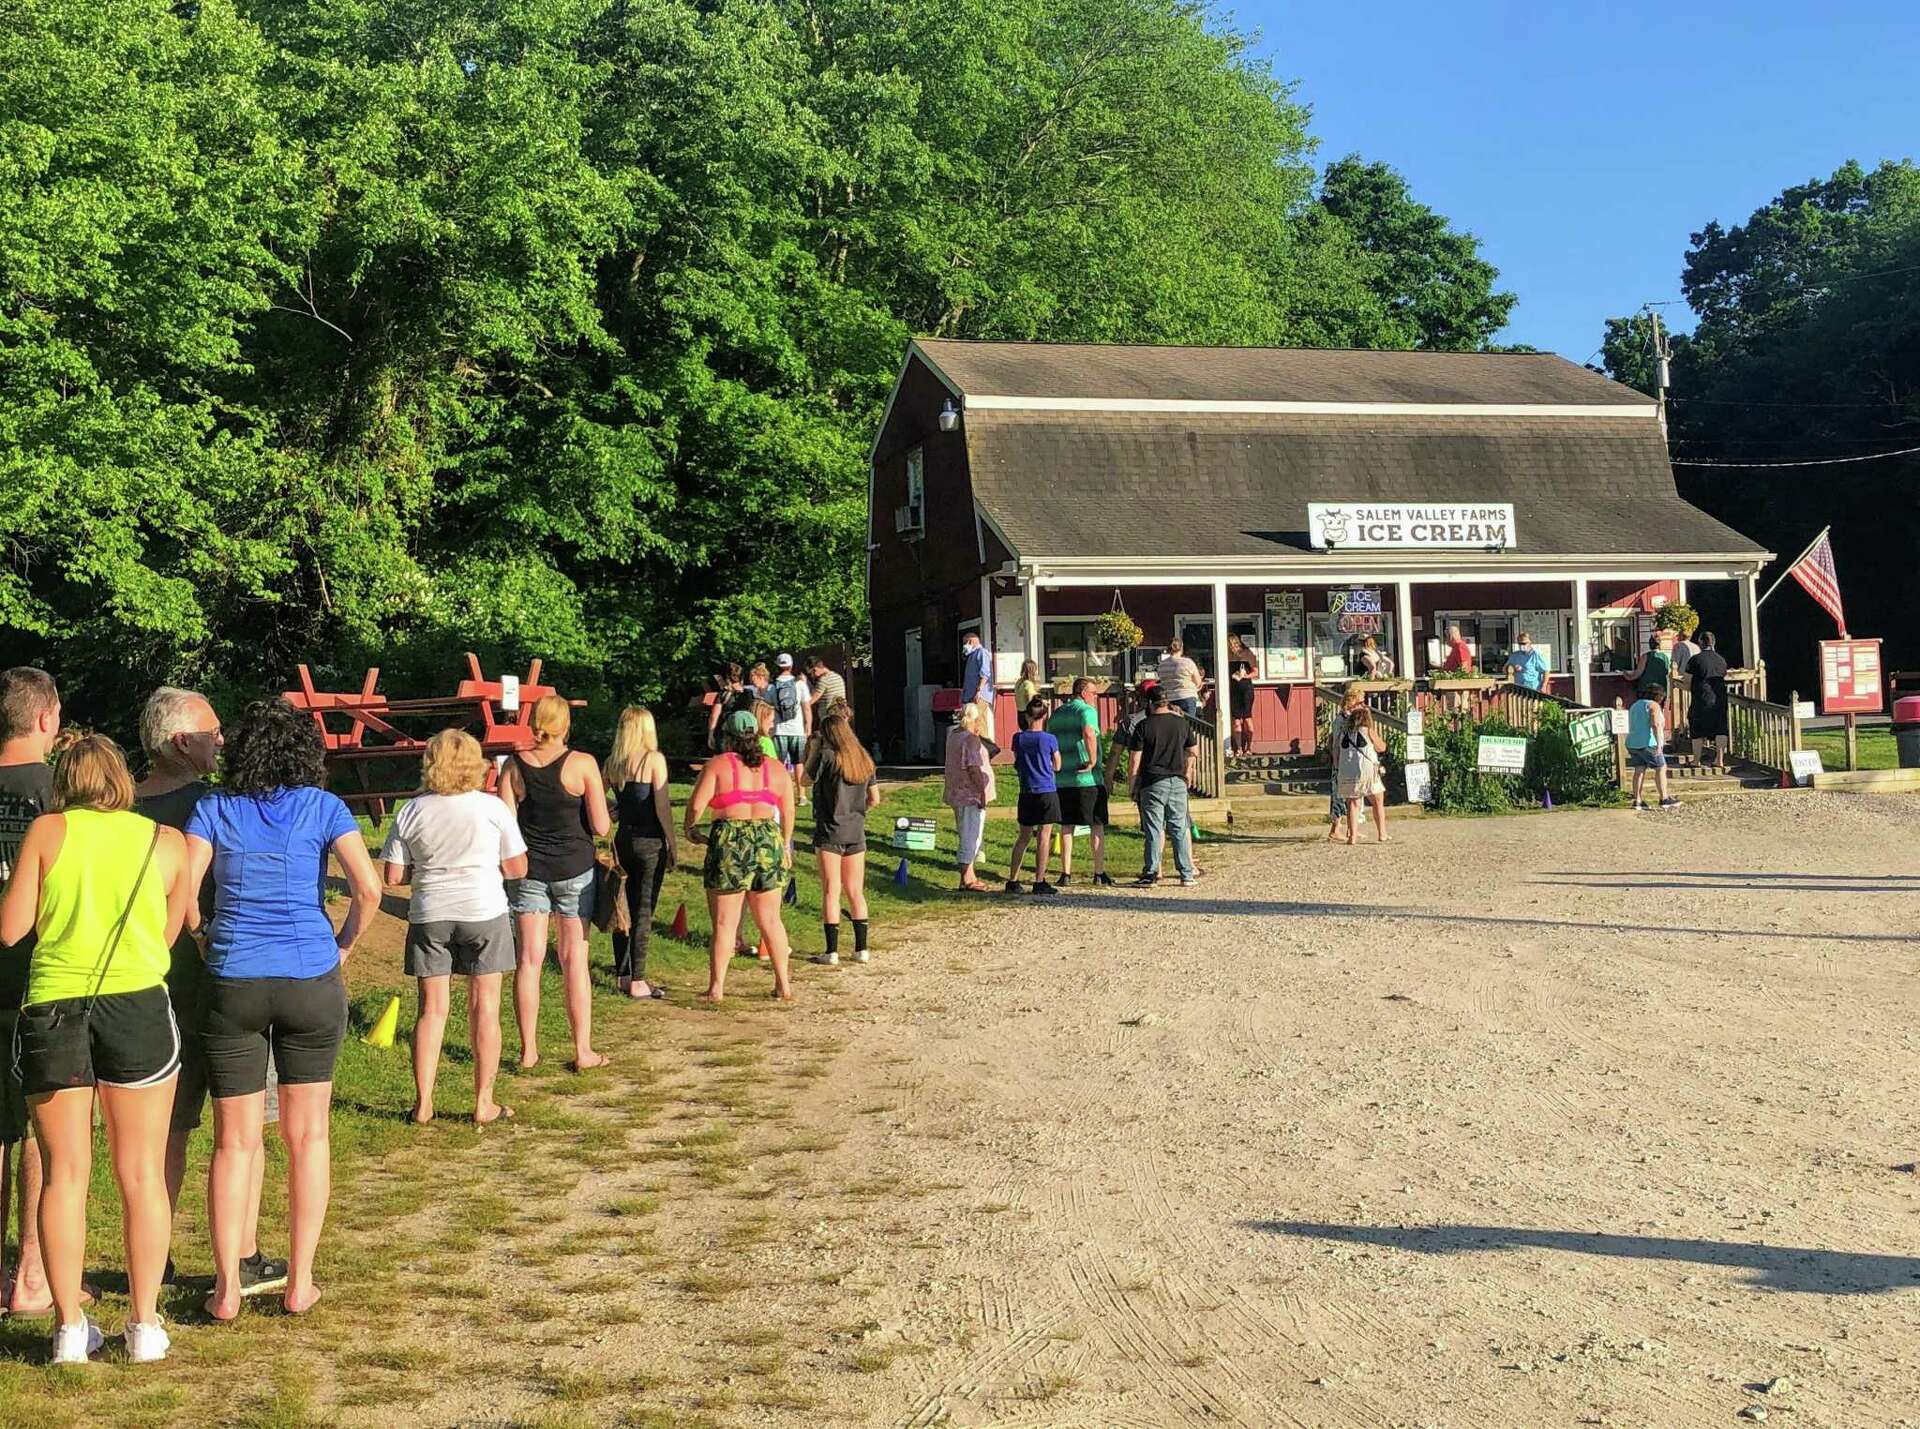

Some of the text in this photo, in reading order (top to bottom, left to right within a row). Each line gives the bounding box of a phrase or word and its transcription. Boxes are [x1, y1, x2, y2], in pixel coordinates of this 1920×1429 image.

[1356, 509, 1507, 521] SALEM VALLEY FARMS
[1358, 524, 1507, 542] ICE CREAM
[1265, 595, 1300, 604] SALEM
[1353, 590, 1372, 602] ICE
[1344, 601, 1381, 612] CREAM
[1338, 614, 1381, 634] OPEN
[1576, 712, 1609, 742] ATM
